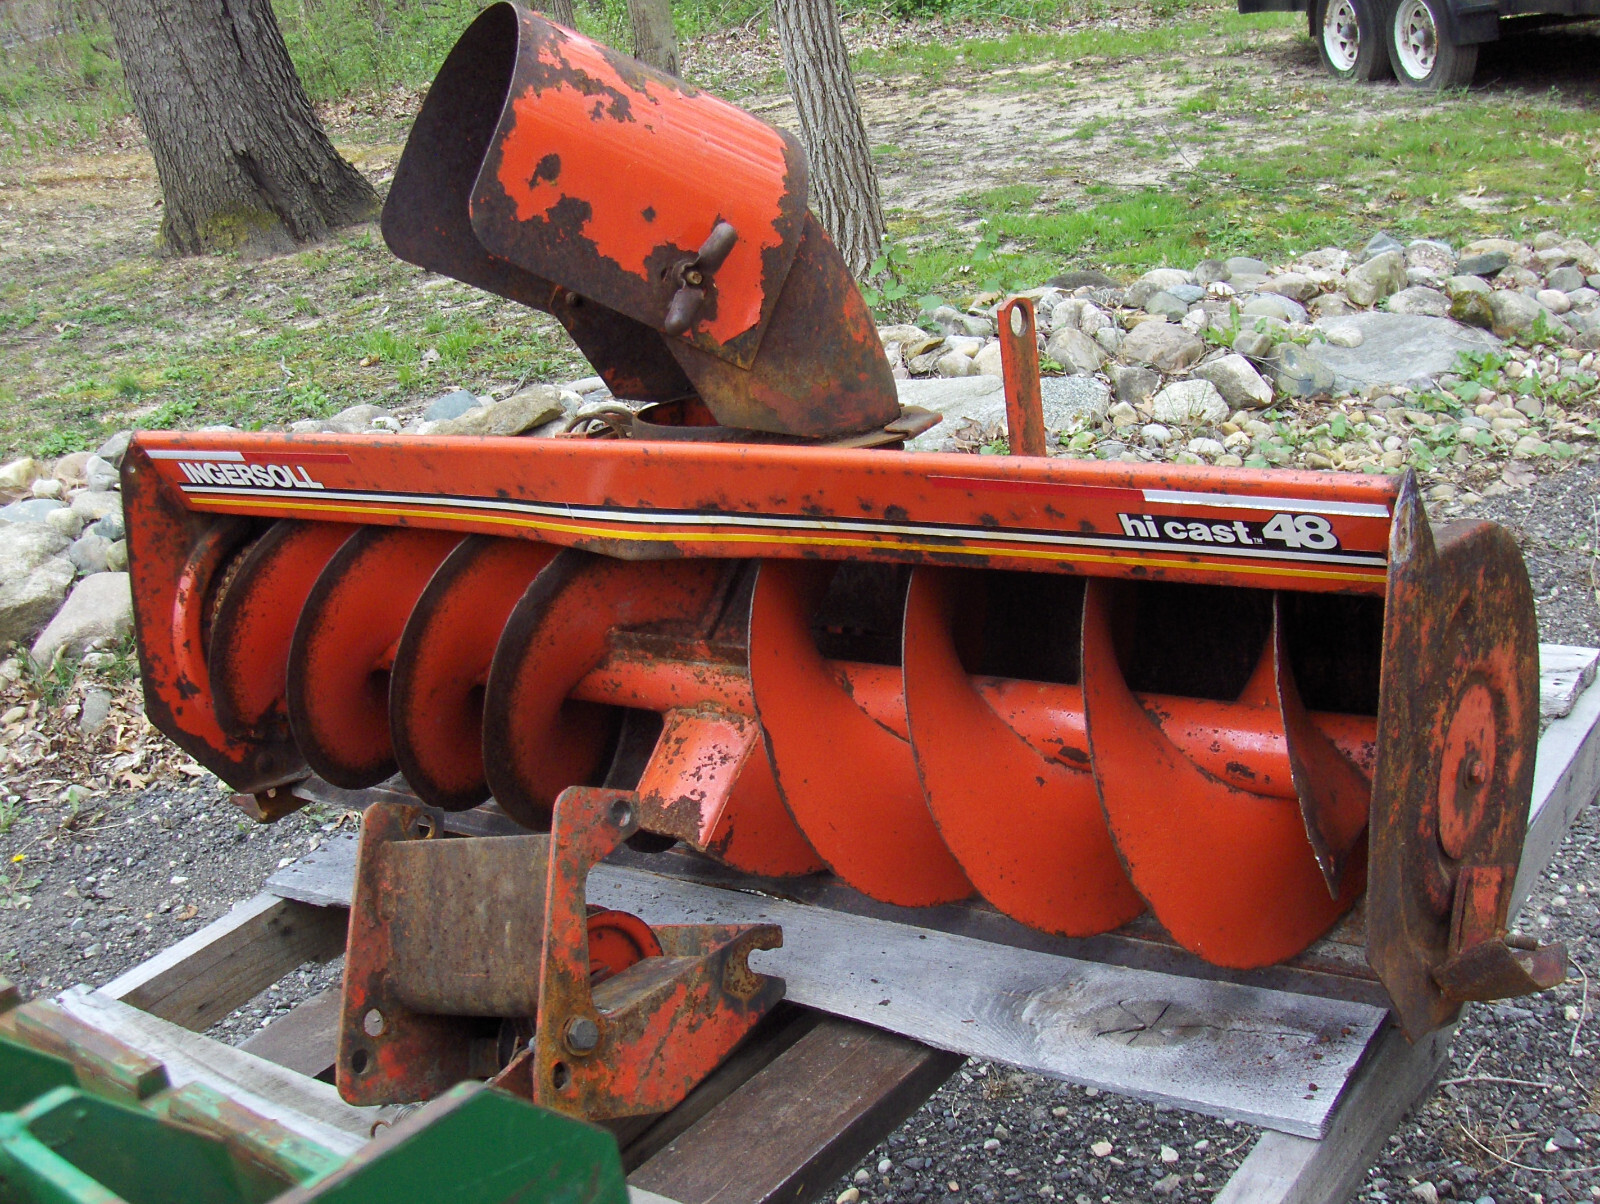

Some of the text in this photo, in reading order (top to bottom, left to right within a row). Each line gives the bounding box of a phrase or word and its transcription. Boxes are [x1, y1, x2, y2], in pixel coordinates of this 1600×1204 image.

[178, 463, 324, 489] INGERSOLL
[1118, 513, 1159, 538] hi
[1262, 513, 1338, 550] 48
